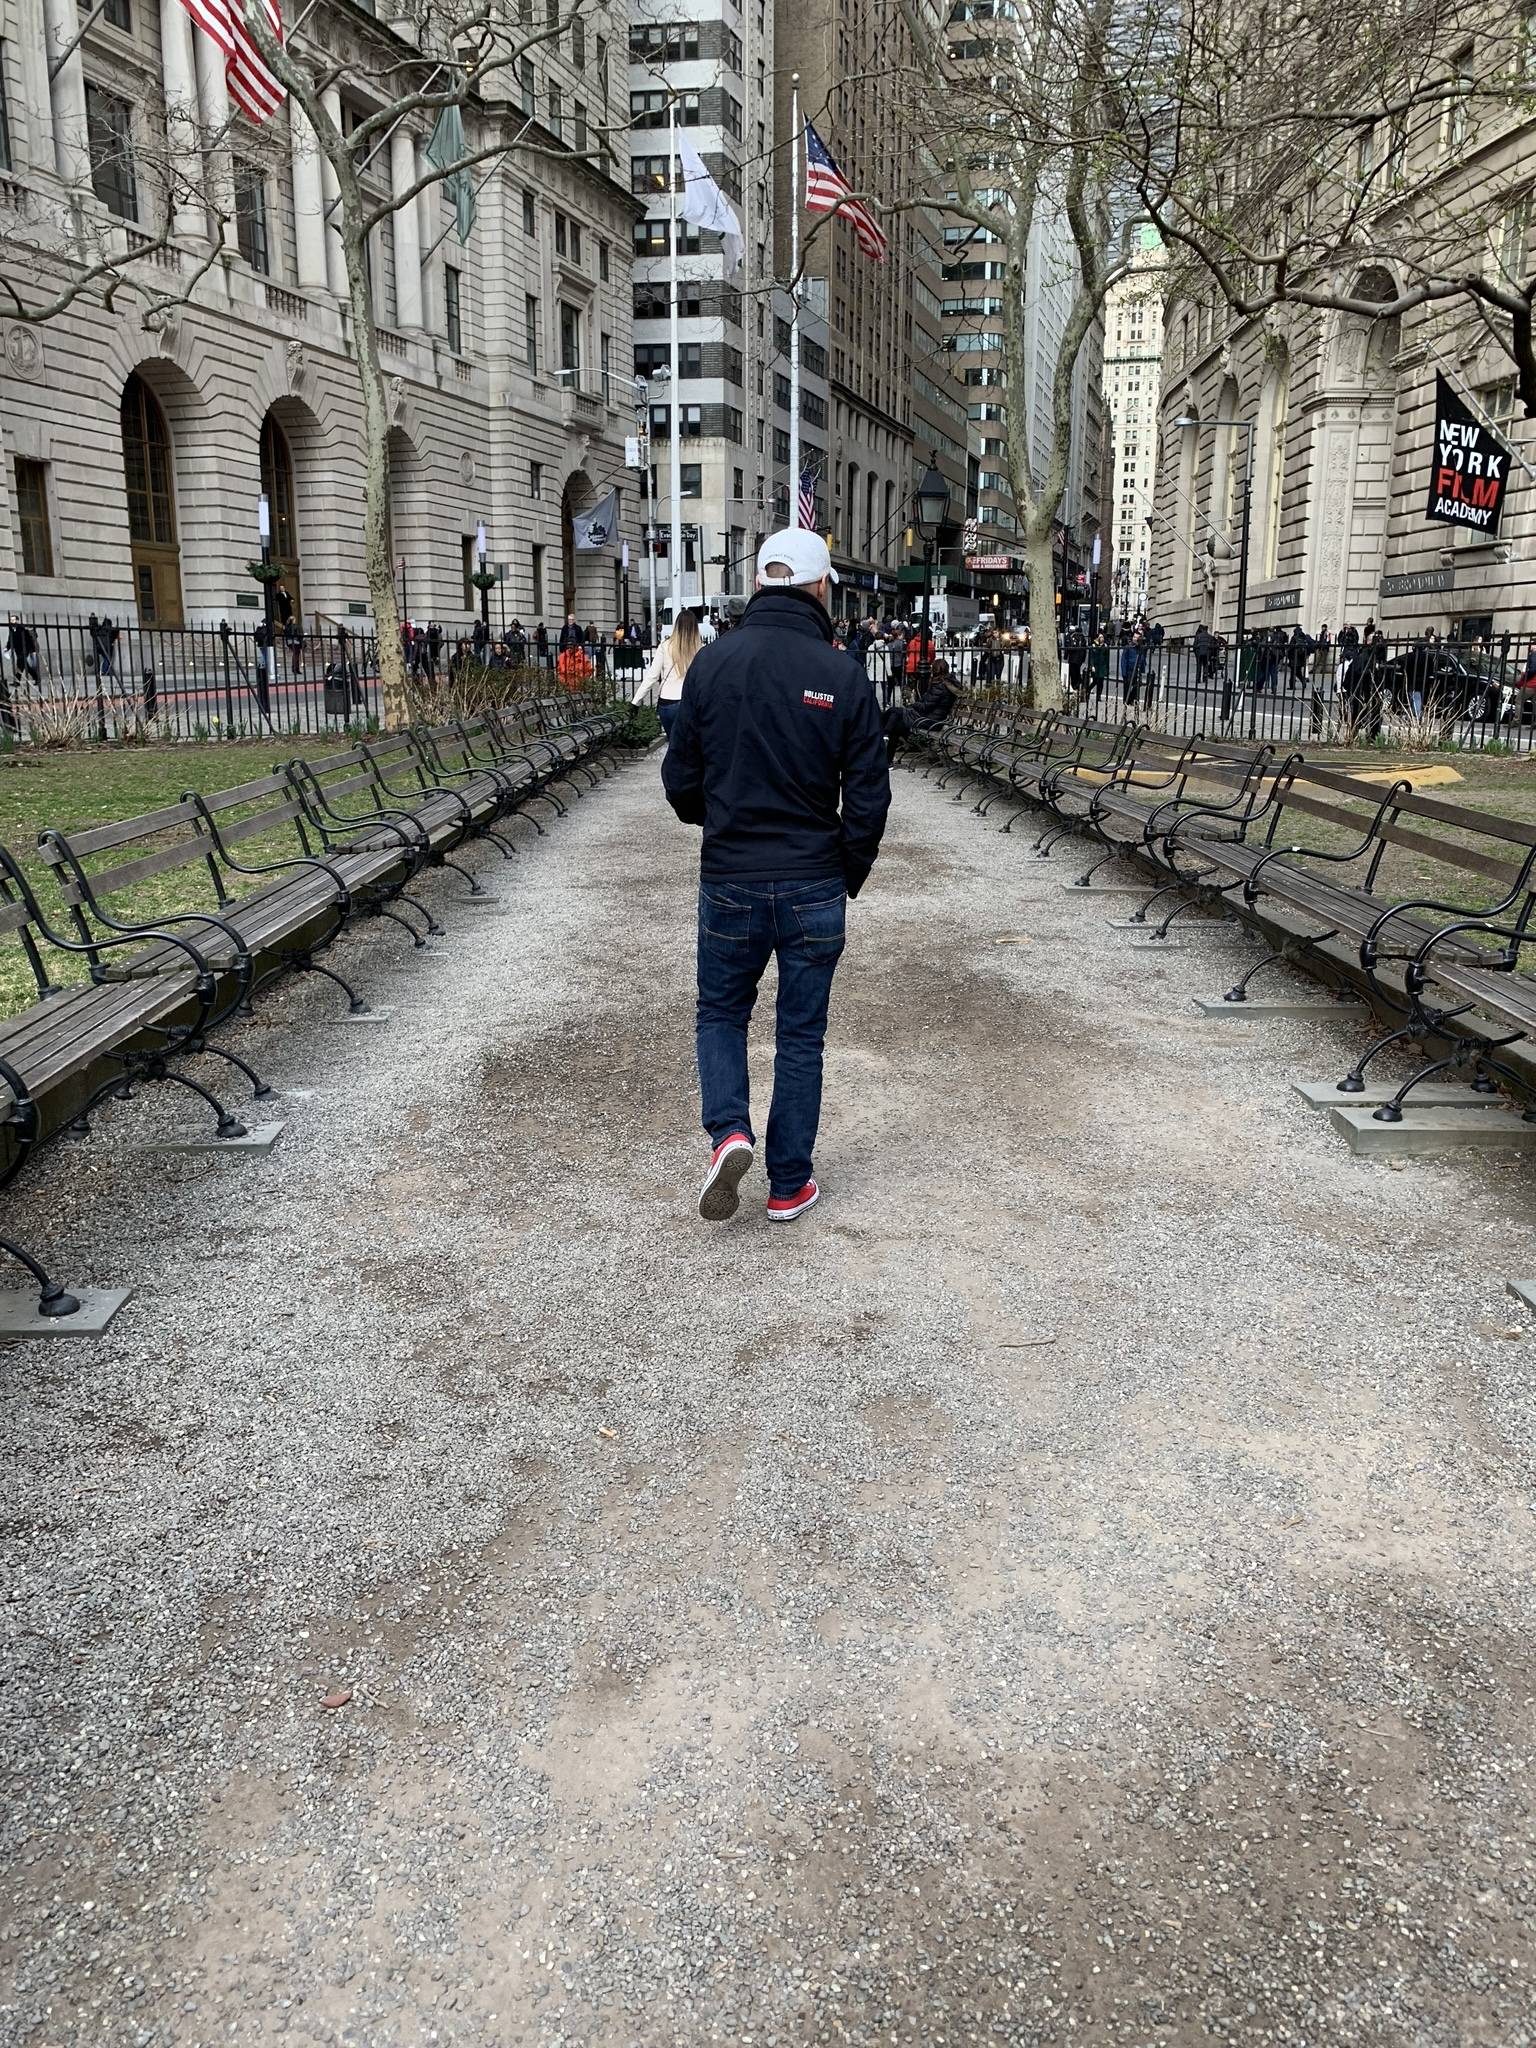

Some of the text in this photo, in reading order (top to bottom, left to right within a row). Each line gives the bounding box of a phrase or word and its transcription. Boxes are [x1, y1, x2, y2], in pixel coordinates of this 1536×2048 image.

[1440, 419, 1480, 449] NEW
[1439, 442, 1504, 479] YORK
[1434, 497, 1492, 526] ACADEMY
[976, 556, 1008, 564] FRIDAYS
[804, 689, 834, 703] HOLLISTER
